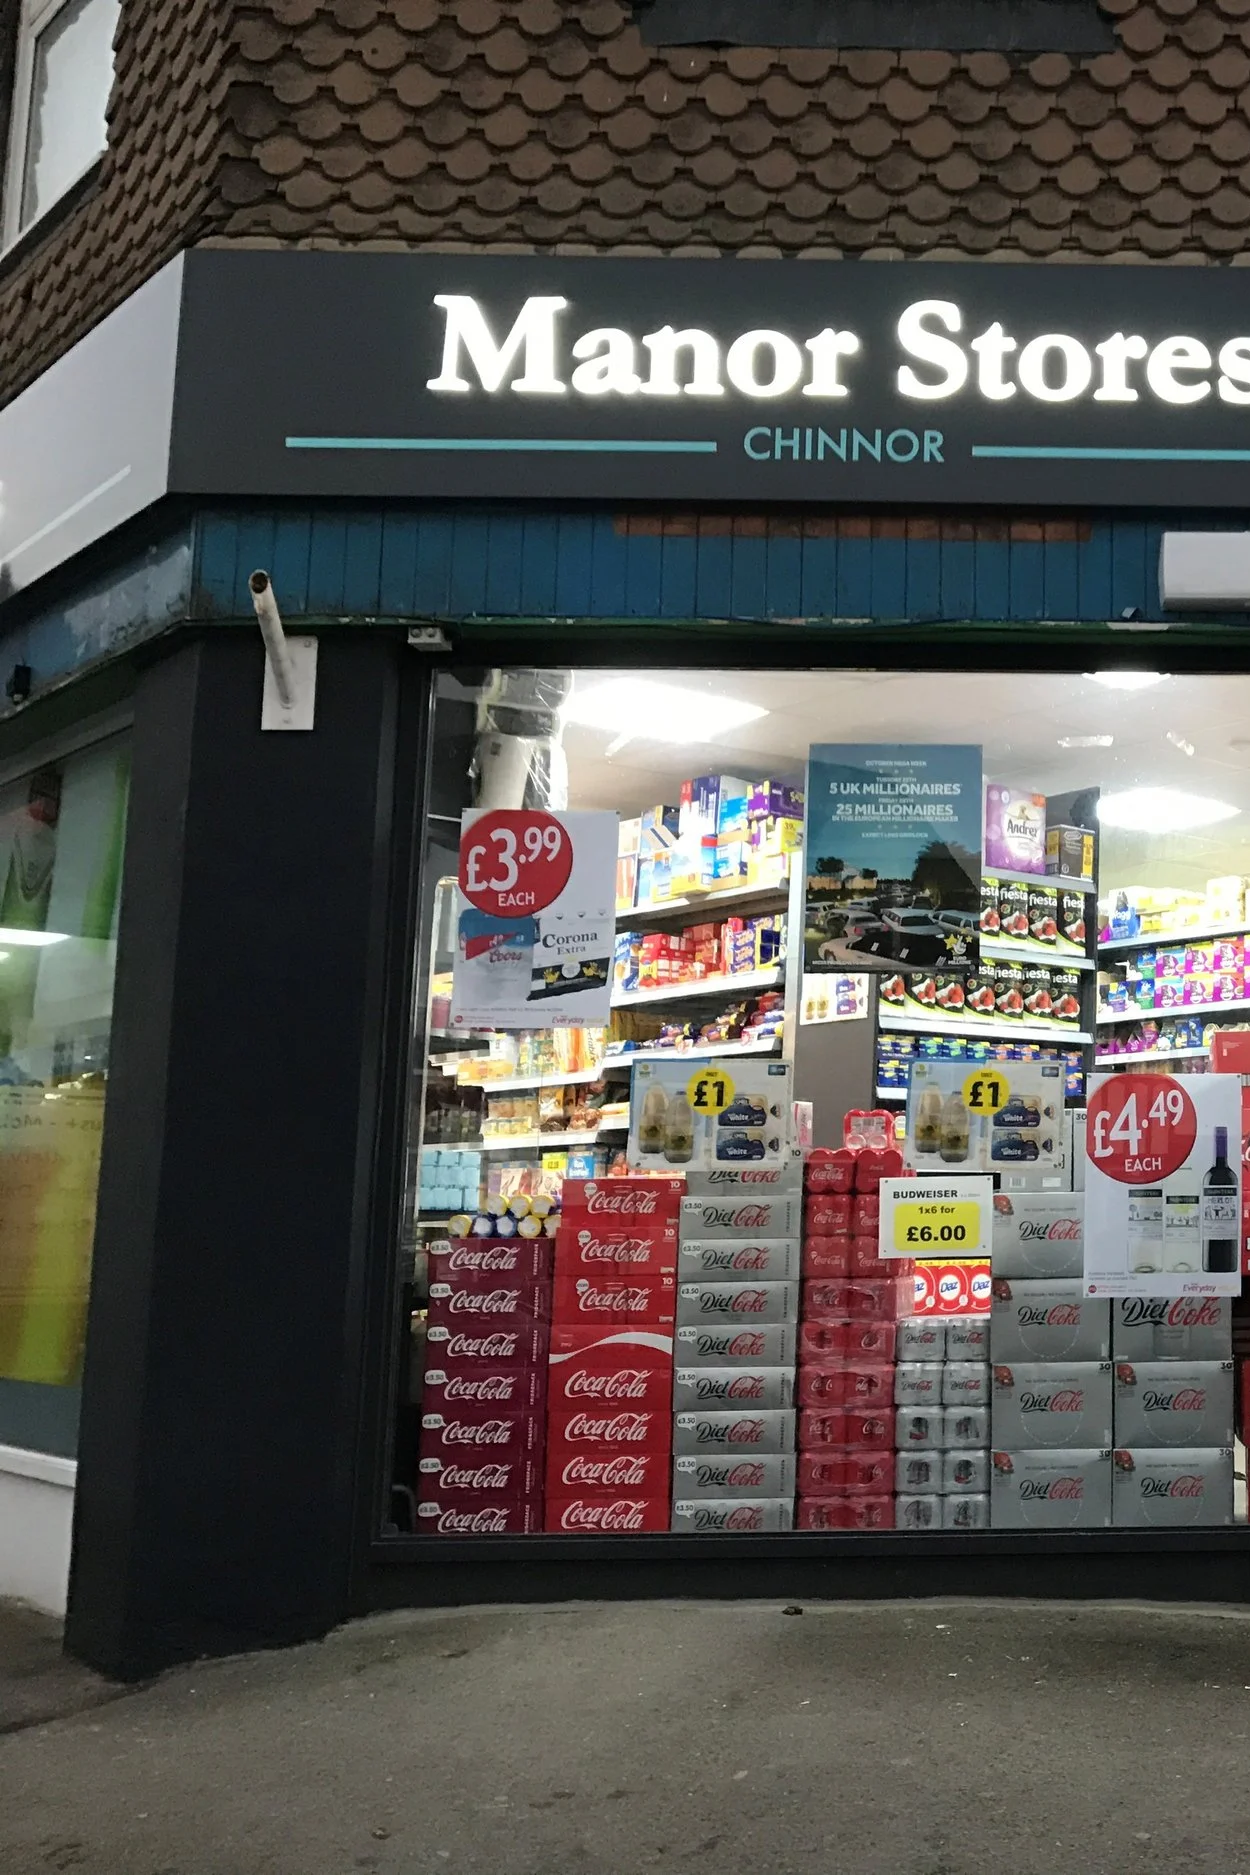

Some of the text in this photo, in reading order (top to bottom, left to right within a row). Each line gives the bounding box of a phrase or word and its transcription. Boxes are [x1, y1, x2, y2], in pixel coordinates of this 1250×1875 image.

[426, 293, 857, 397] Manor
[743, 426, 944, 466] CHINNOR
[829, 782, 961, 795] 5 UK MILLIONAIRES
[836, 803, 954, 815] 25 MILLIONAIRES
[1007, 819, 1038, 838] Andrex
[466, 826, 561, 891] £3.99
[498, 892, 535, 906] EACH
[1000, 887, 1028, 900] fiesta
[1029, 893, 1057, 906] fiesta
[542, 931, 599, 949] Corona
[557, 944, 586, 955] Extra
[694, 1081, 725, 1107] £1
[969, 1081, 1000, 1108] £1
[1094, 1089, 1184, 1158] £4.49
[1125, 1157, 1162, 1172] EACH
[893, 1190, 958, 1199] BUDWEISER
[703, 1206, 736, 1227] Diet
[734, 1204, 773, 1227] Coke
[919, 1206, 955, 1215] 1x6 for
[907, 1225, 966, 1242] £6.00
[1019, 1218, 1082, 1241] Diet Coke
[449, 1246, 521, 1271] Coca-Cola
[701, 1249, 735, 1270] Diet
[733, 1247, 770, 1270] Coke
[914, 1282, 924, 1291] az
[940, 1281, 958, 1293] Daz
[973, 1280, 990, 1292] Daz
[449, 1289, 521, 1314] Coca-Cola
[700, 1292, 733, 1313] Diet
[731, 1289, 770, 1313] Coke
[1121, 1297, 1222, 1327] Diet Coke
[1017, 1303, 1081, 1327] Diet Coke
[446, 1333, 520, 1357] Coca-Cola
[697, 1334, 730, 1357] Diet
[728, 1332, 767, 1355] Coke
[1099, 1363, 1111, 1372] 30
[1221, 1362, 1232, 1371] 30
[443, 1376, 517, 1400] Coca-Cola
[564, 1369, 654, 1399] Coca-Cola
[696, 1377, 730, 1400] Diet
[728, 1375, 766, 1399] Coke
[1020, 1390, 1083, 1413] Diet Coke
[1143, 1388, 1206, 1412] Diet Coke
[442, 1420, 515, 1445] Coca-Cola
[564, 1412, 653, 1442] Coca-Cola
[696, 1421, 729, 1443] Diet
[728, 1419, 766, 1443] Coke
[439, 1464, 513, 1489] Coca-Cola
[562, 1456, 651, 1485] Coca-Cola
[696, 1465, 729, 1487] Diet
[728, 1463, 766, 1486] Coke
[1020, 1477, 1083, 1500] Diet Coke
[1141, 1475, 1204, 1498] Diet Coke
[437, 1508, 511, 1533] Coca-Cola
[561, 1500, 650, 1530] Coca-Cola
[695, 1508, 727, 1531] Diet
[726, 1507, 764, 1530] Coke
